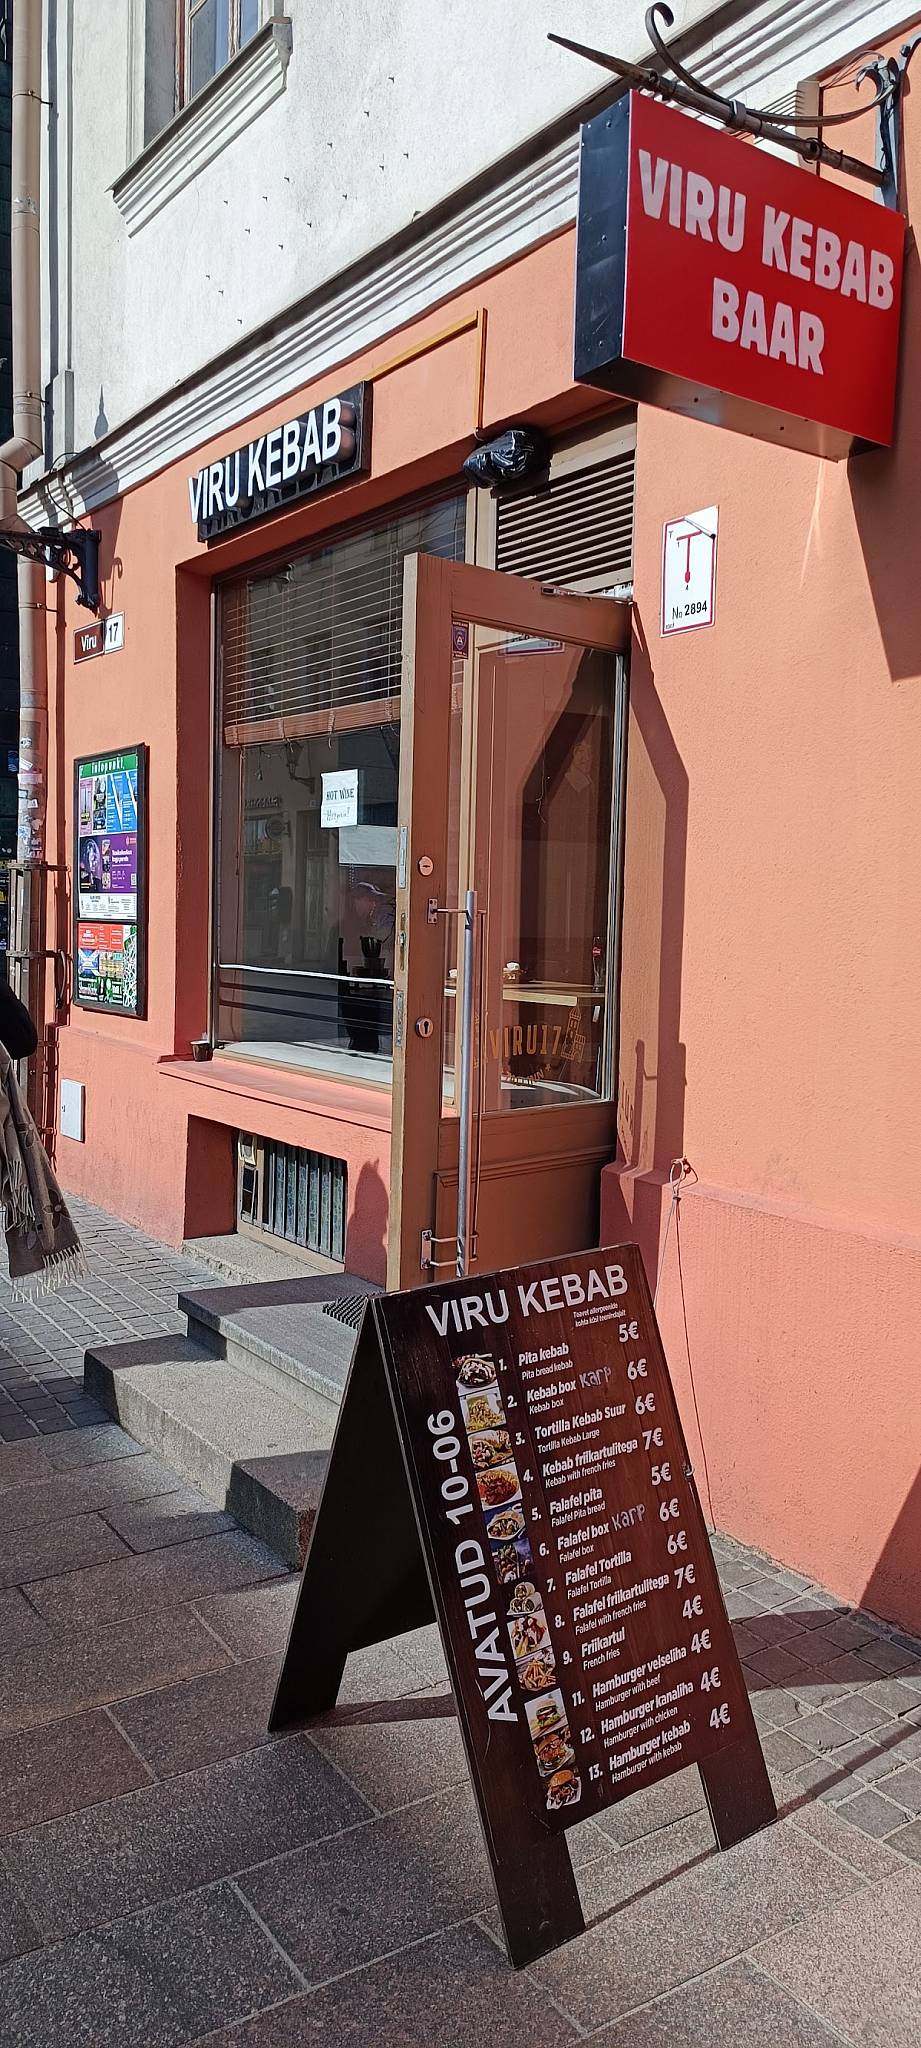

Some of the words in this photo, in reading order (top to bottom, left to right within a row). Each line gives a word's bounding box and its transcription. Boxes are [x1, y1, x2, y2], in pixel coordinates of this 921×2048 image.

[638, 148, 746, 253] VIRU
[761, 204, 895, 311] KEBAB
[711, 277, 825, 375] BAAR
[188, 450, 240, 524] VIRU
[247, 397, 342, 497] KEBAB
[684, 600, 708, 616] 2894
[80, 633, 97, 652] Viru
[108, 622, 119, 643] 17
[489, 1024, 562, 1059] VIRU17
[425, 1289, 509, 1337] VIRU
[517, 1264, 629, 1317] KEBAB
[498, 1358, 508, 1371] 1.
[518, 1352, 538, 1367] Pita
[539, 1342, 570, 1360] kebab
[619, 1321, 640, 1343] 5€
[521, 1368, 534, 1380] Pita
[536, 1364, 554, 1377] bread
[554, 1360, 574, 1374] kebab
[627, 1357, 649, 1381] 6€
[507, 1395, 518, 1409] 2.
[526, 1382, 558, 1403] Kebab
[558, 1379, 577, 1393] box
[529, 1400, 551, 1415] Kebab
[551, 1397, 564, 1409] box
[515, 1431, 526, 1445] 3.
[534, 1419, 571, 1440] Tortilla
[571, 1408, 603, 1429] Kebab
[604, 1403, 627, 1420] Suur
[635, 1393, 656, 1415] 6€
[523, 1468, 534, 1482] 4.
[542, 1456, 574, 1477] Kebab
[574, 1438, 639, 1468] friikartulitega
[642, 1427, 664, 1450] 7€
[537, 1439, 561, 1454] Tortilla
[560, 1432, 582, 1447] Kebab
[582, 1428, 600, 1442] Large
[428, 1408, 474, 1525] 10-06
[545, 1473, 567, 1488] Kebab
[567, 1469, 581, 1482] with
[581, 1463, 601, 1477] french
[602, 1459, 616, 1471] fries
[531, 1507, 542, 1521] 5.
[550, 1491, 582, 1516] Falafel
[583, 1487, 603, 1506] pita
[651, 1462, 672, 1486] 5€
[659, 1498, 680, 1521] 6€
[551, 1511, 573, 1528] Falafel
[573, 1506, 587, 1519] Pita
[587, 1500, 606, 1515] bread
[539, 1542, 550, 1557] 6.
[557, 1529, 590, 1550] Falafel
[590, 1521, 610, 1540] box
[559, 1548, 581, 1564] Falafel
[581, 1542, 595, 1557] box
[546, 1577, 556, 1593] 7.
[565, 1565, 598, 1586] Falafel
[598, 1550, 632, 1573] Tortilla
[667, 1530, 688, 1555] 6€
[554, 1614, 566, 1629] 8.
[572, 1595, 606, 1622] Falafel
[606, 1573, 670, 1610] friikartulitega
[674, 1563, 696, 1589] 7€
[567, 1583, 590, 1600] Falafel
[590, 1575, 612, 1593] Tortilla
[455, 1540, 519, 1722] AVATUD
[562, 1650, 573, 1665] 9.
[581, 1626, 626, 1658] Friikartul
[682, 1594, 704, 1619] 4€
[575, 1619, 598, 1636] Falafel
[597, 1613, 612, 1628] with
[612, 1606, 633, 1622] french
[633, 1600, 647, 1614] fries
[572, 1690, 585, 1707] 11.
[592, 1663, 647, 1698] Hamburger
[691, 1629, 712, 1654] 4€
[583, 1652, 606, 1671] French
[605, 1647, 621, 1662] fries
[580, 1727, 595, 1744] 12.
[601, 1700, 655, 1735] Hamburger
[655, 1681, 694, 1709] kanaliha
[700, 1666, 721, 1692] 4€
[595, 1689, 632, 1712] Hamburger
[631, 1680, 647, 1696] with
[646, 1672, 661, 1690] beef
[589, 1763, 603, 1781] 13.
[609, 1736, 661, 1772] Hamburger
[661, 1719, 691, 1746] kebab
[709, 1702, 731, 1729] 4€
[604, 1726, 640, 1749] Hamburger
[640, 1716, 655, 1732] with
[654, 1705, 678, 1724] chicken
[612, 1759, 648, 1784] Hamburger
[648, 1750, 663, 1766] with
[662, 1741, 682, 1759] kebab
